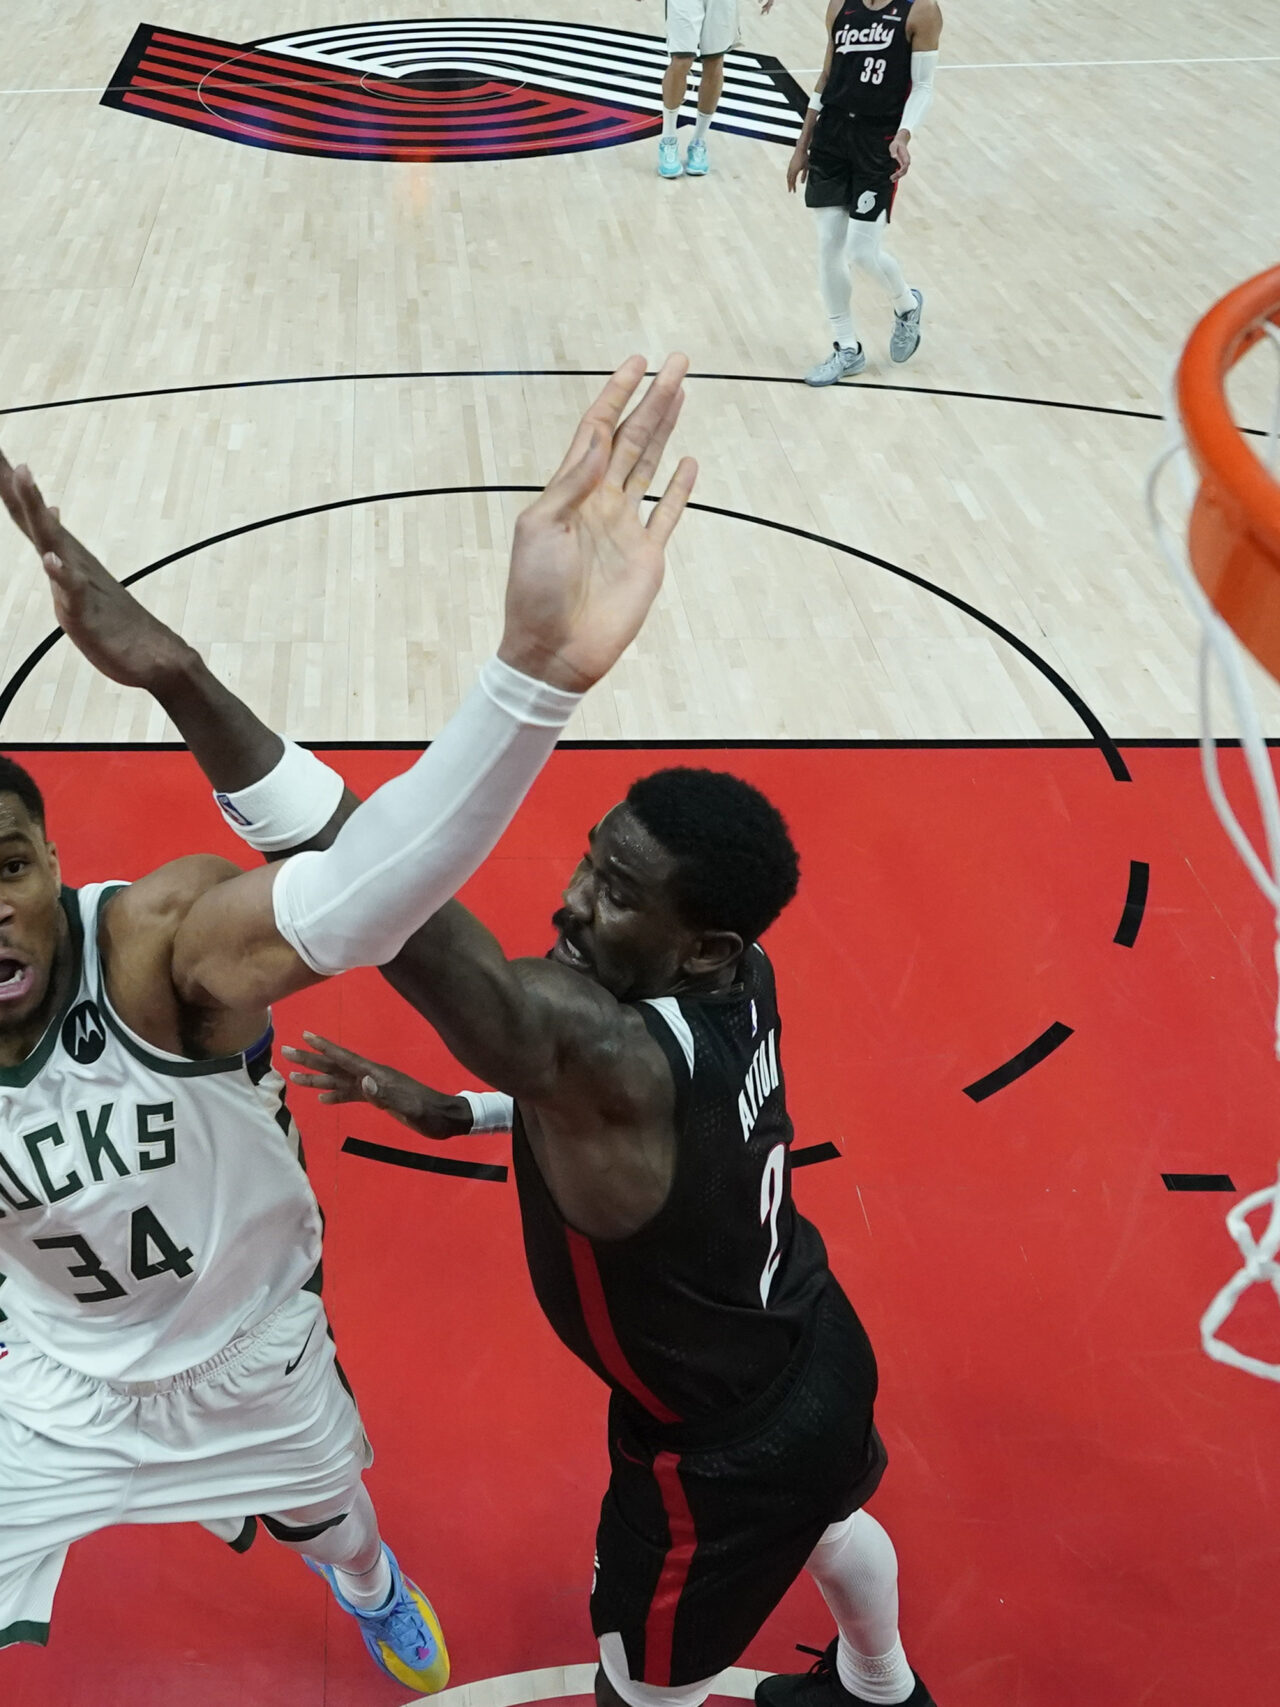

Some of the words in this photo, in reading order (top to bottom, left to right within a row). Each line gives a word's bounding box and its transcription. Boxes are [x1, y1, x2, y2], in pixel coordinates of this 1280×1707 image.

[835, 22, 895, 55] ripcity
[860, 56, 887, 85] 33
[32, 1205, 194, 1303] 34
[759, 1142, 785, 1310] 2
